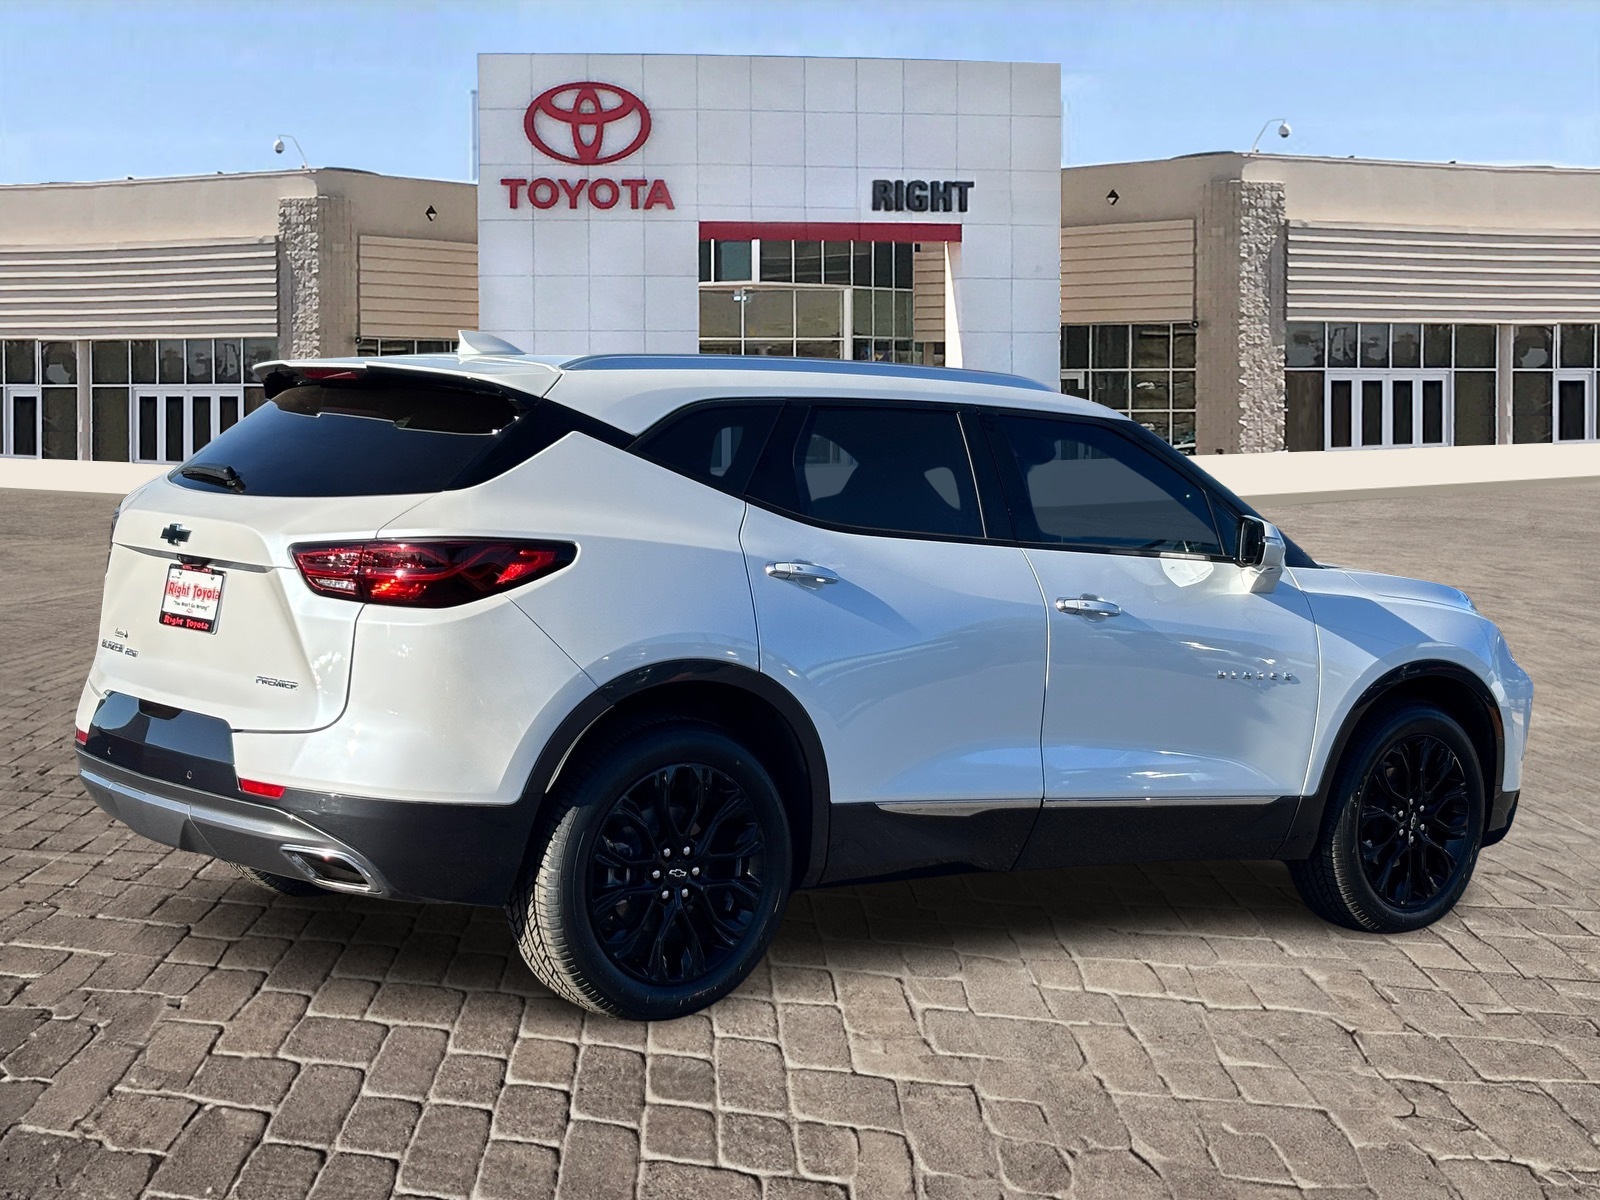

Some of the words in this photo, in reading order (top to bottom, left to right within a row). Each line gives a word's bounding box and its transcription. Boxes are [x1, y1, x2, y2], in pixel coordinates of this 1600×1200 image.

[500, 178, 676, 211] TOYOTA
[871, 179, 975, 213] RIGHT
[168, 582, 190, 597] Right
[192, 586, 220, 600] Toyota
[164, 615, 184, 625] Right
[186, 619, 209, 630] Toyota
